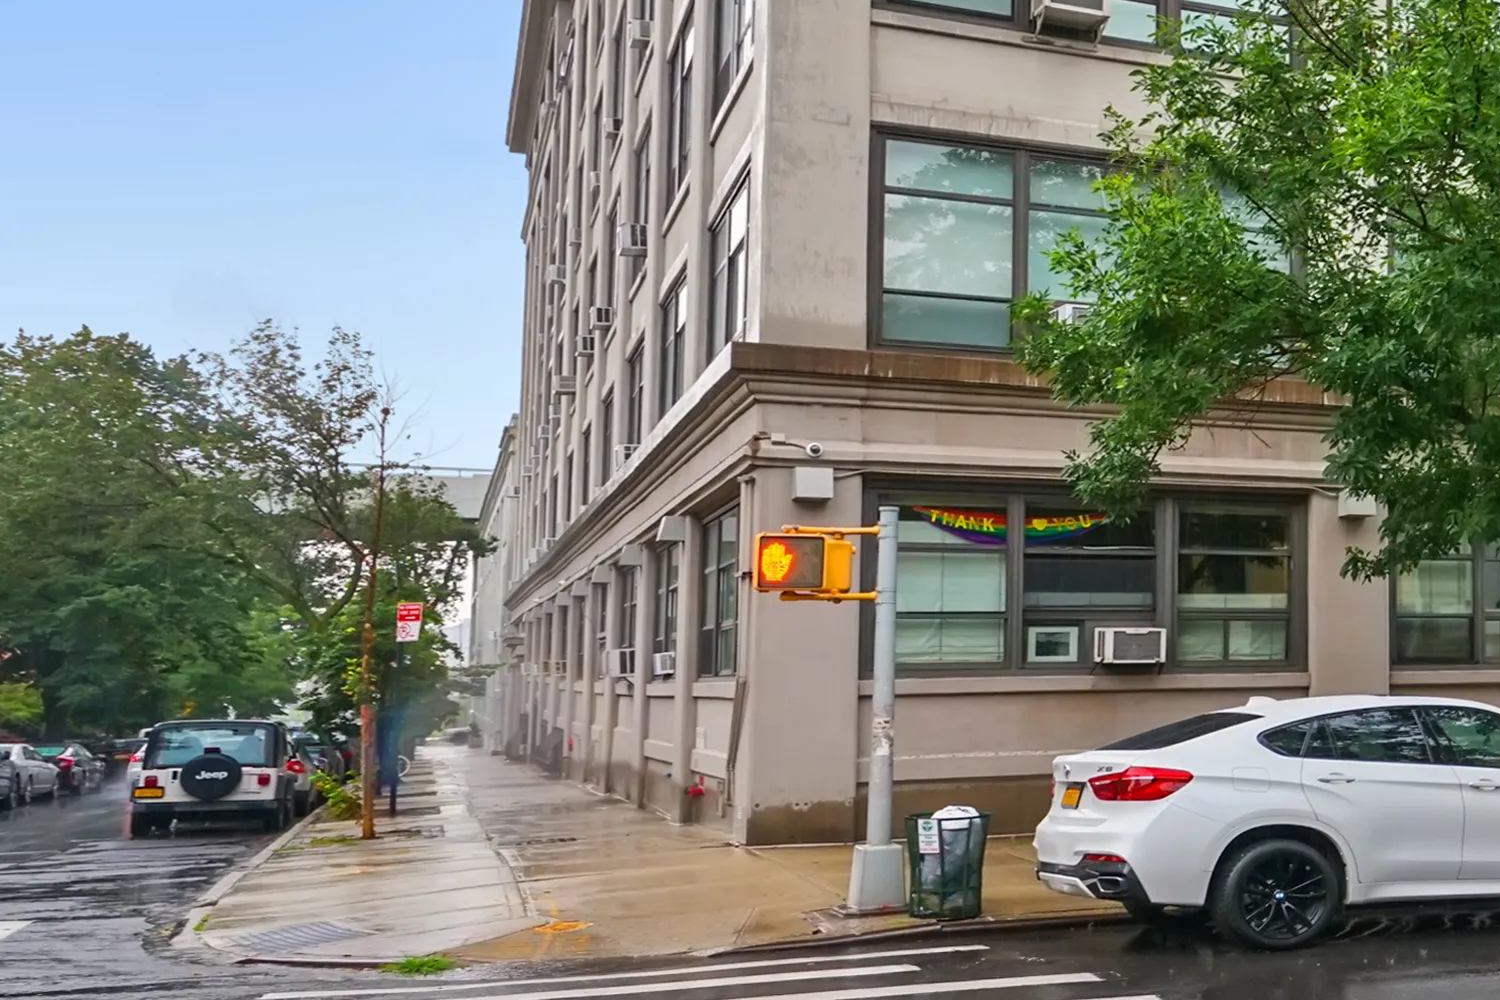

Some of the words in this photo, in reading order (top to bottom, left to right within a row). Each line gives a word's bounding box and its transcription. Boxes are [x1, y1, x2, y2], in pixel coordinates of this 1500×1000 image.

[930, 509, 995, 531] THANK
[1053, 514, 1092, 531] YOU
[195, 770, 229, 780] Jeep
